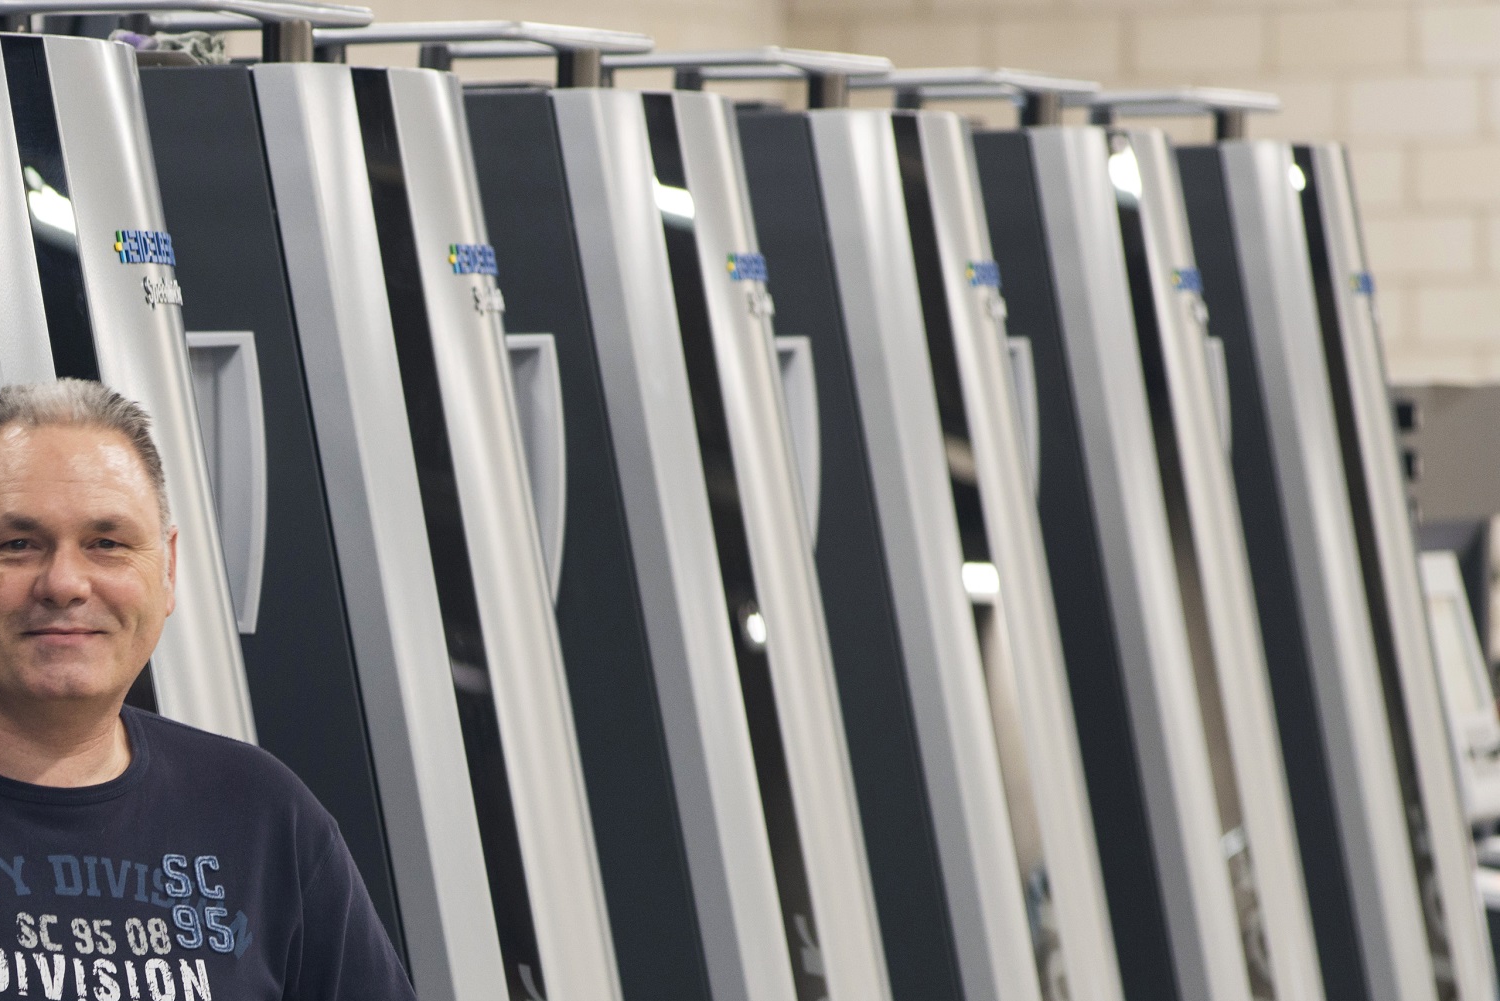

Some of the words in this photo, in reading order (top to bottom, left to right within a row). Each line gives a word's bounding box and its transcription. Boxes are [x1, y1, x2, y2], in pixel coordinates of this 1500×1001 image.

[162, 853, 225, 899] SC
[47, 854, 253, 960] DIVISN
[173, 904, 234, 953] 95
[16, 911, 63, 952] SC
[70, 917, 117, 955] 95
[125, 917, 172, 956] 08
